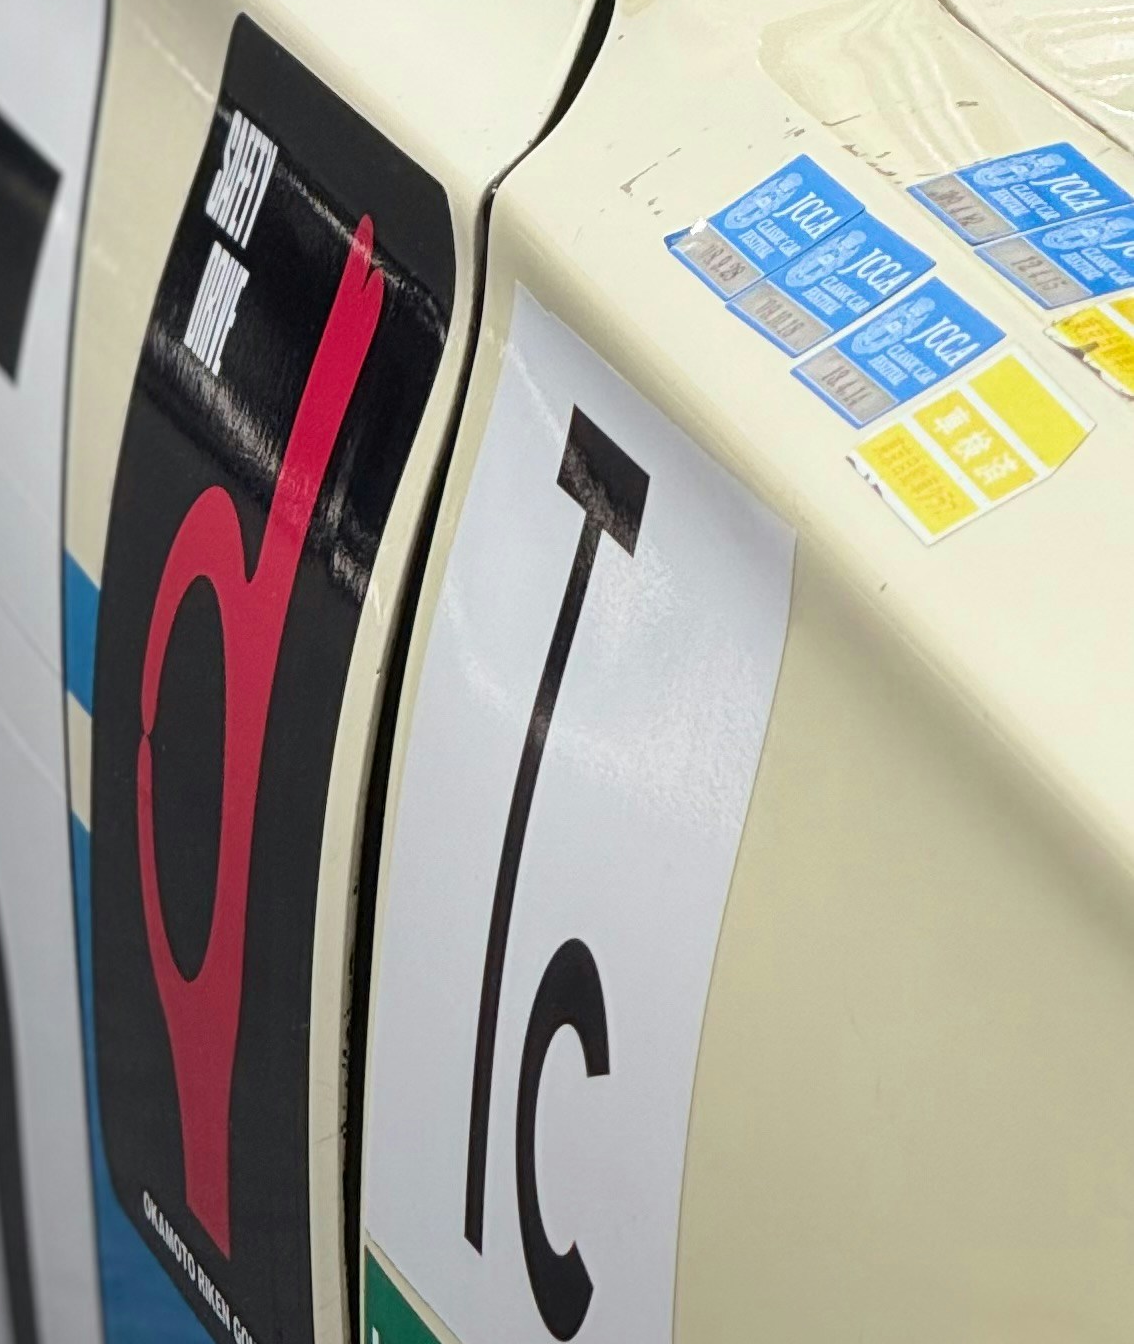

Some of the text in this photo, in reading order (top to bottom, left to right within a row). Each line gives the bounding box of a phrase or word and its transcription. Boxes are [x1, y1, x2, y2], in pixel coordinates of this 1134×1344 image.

[204, 109, 279, 250] SAFETY
[1028, 172, 1110, 214] JCCA
[755, 218, 802, 257] CLASSIC CAR
[771, 191, 842, 241] JCCA
[836, 247, 912, 296] JCCA
[182, 240, 250, 377] DRIVE
[903, 315, 981, 368] JCCA
[143, 1190, 196, 1282] OKAMOTO
[197, 1264, 231, 1331] RIKEN
